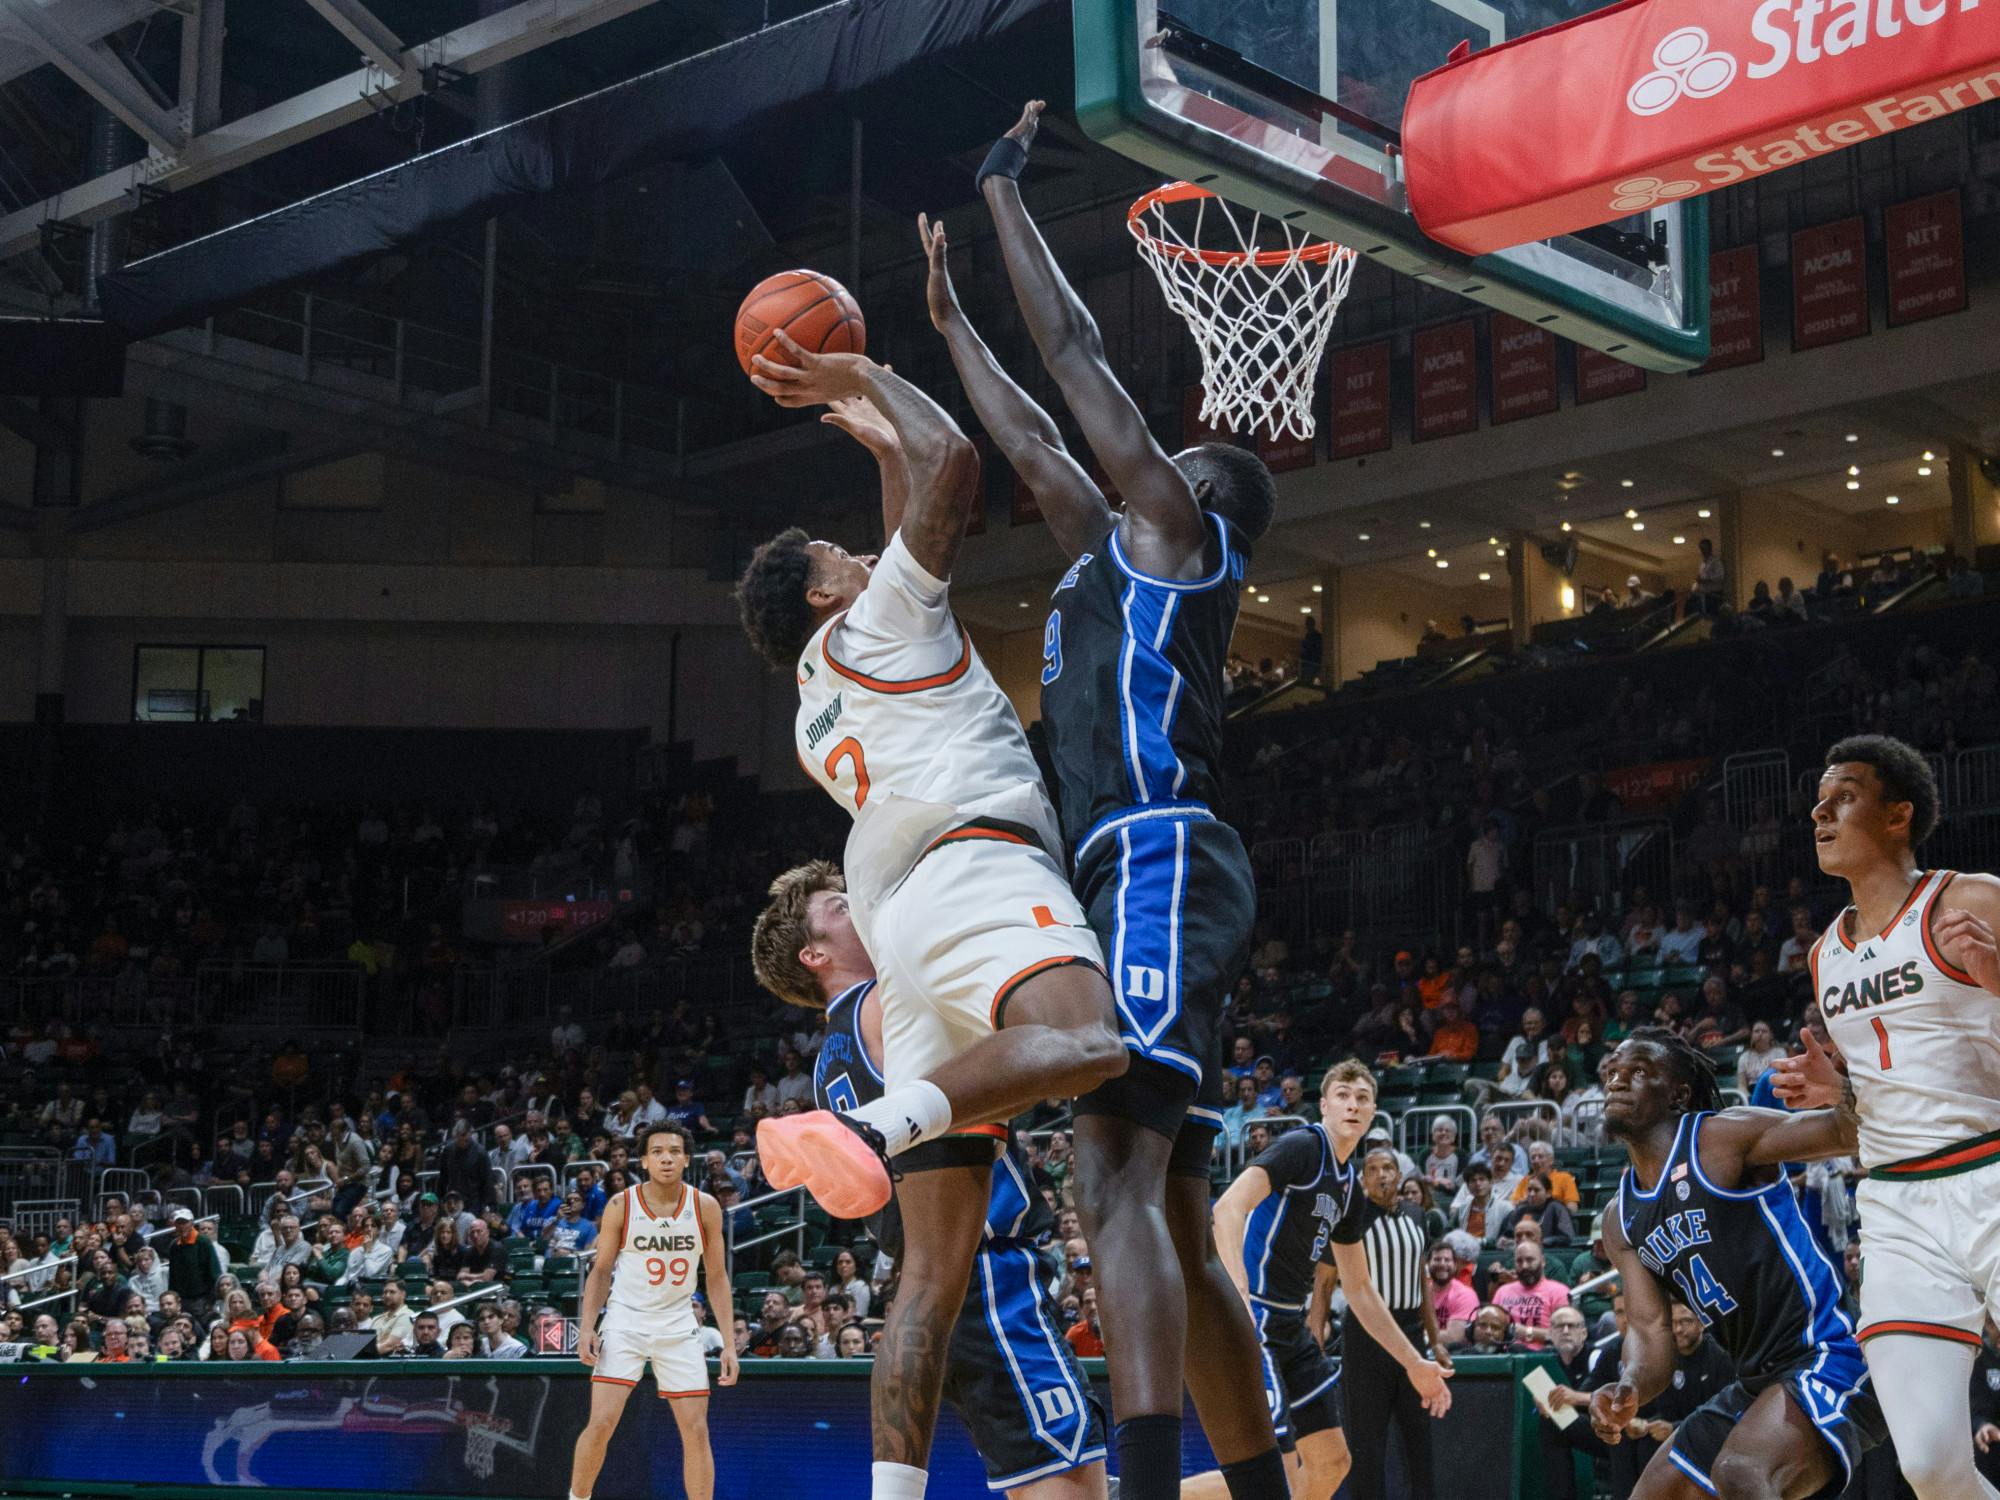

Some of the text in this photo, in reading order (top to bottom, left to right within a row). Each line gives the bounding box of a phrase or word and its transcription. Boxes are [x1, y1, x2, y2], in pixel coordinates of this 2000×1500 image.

[1694, 119, 1870, 184] State
[1906, 225, 1943, 248] NIT
[1041, 608, 1063, 686] 9
[805, 691, 843, 750] JOHNSON
[1822, 961, 1924, 1019] CANES
[1871, 1016, 1892, 1071] 1
[633, 1235, 695, 1252] CANES
[646, 1257, 690, 1287] 99
[1672, 1253, 1739, 1330] 14
